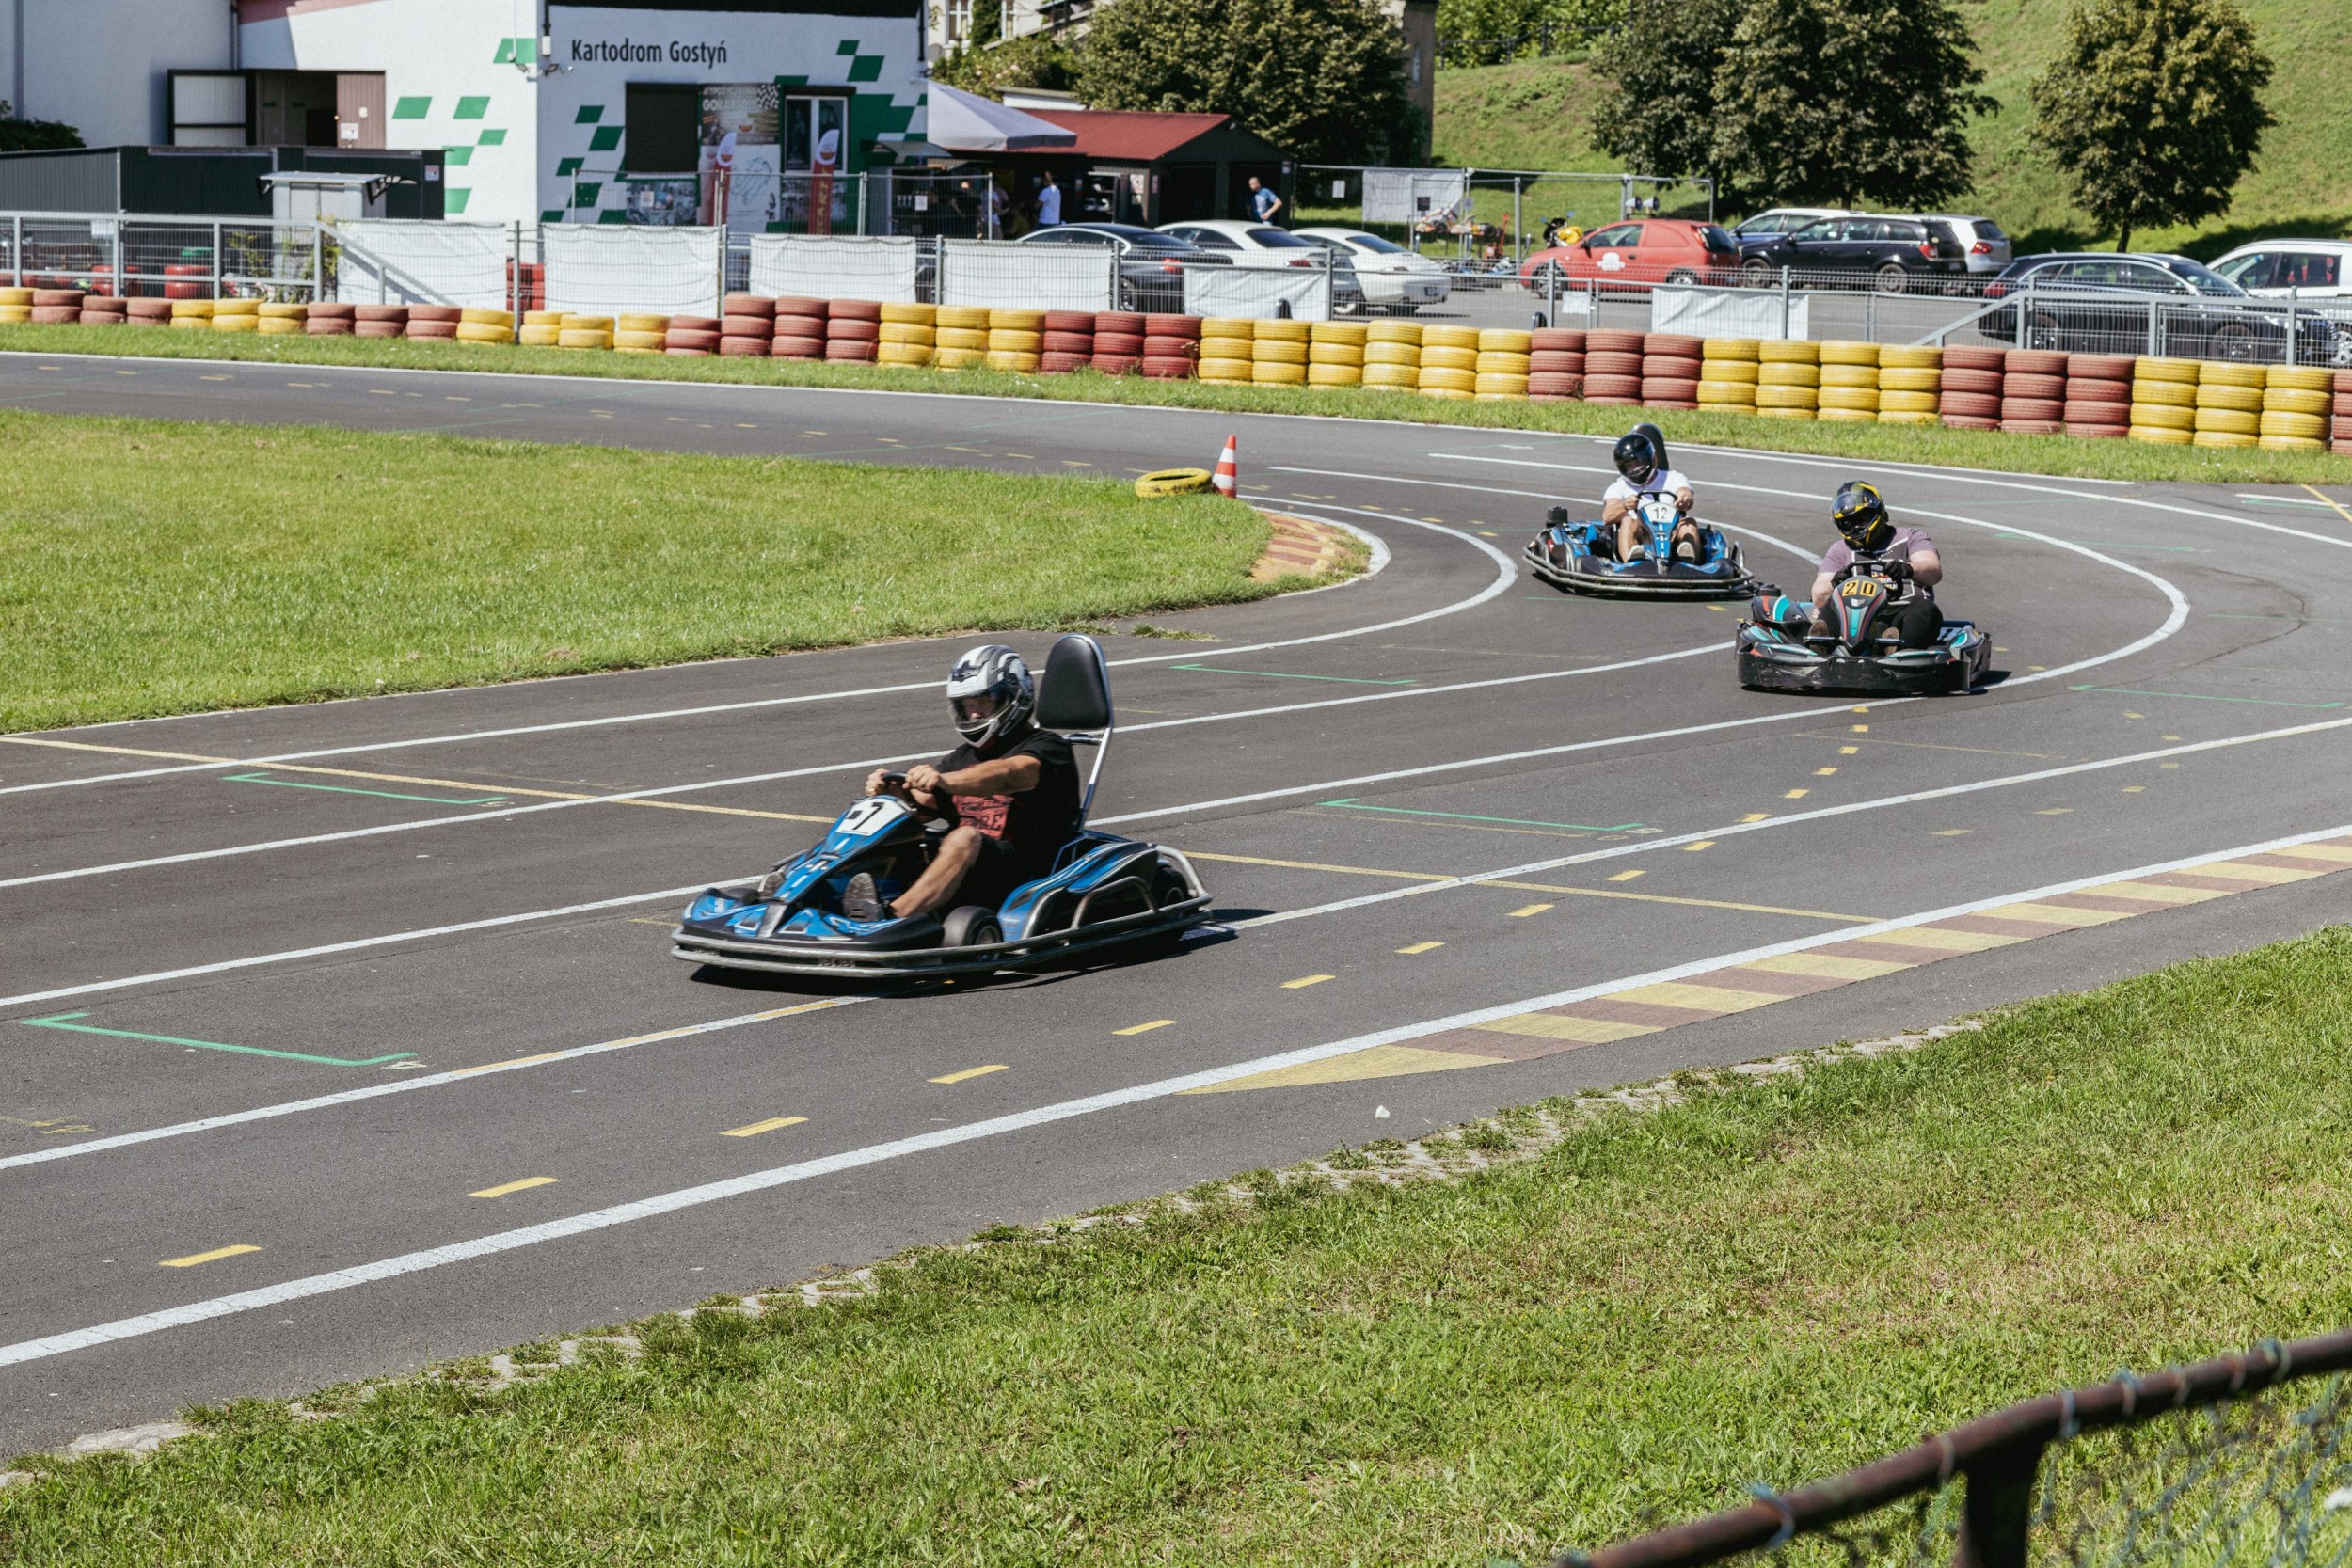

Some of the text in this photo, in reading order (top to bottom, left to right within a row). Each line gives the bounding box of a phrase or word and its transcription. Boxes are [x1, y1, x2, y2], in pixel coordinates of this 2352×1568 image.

[571, 38, 727, 69] Kartodrom Gostyń
[1653, 507, 1668, 519] 12
[1844, 582, 1875, 594] 20
